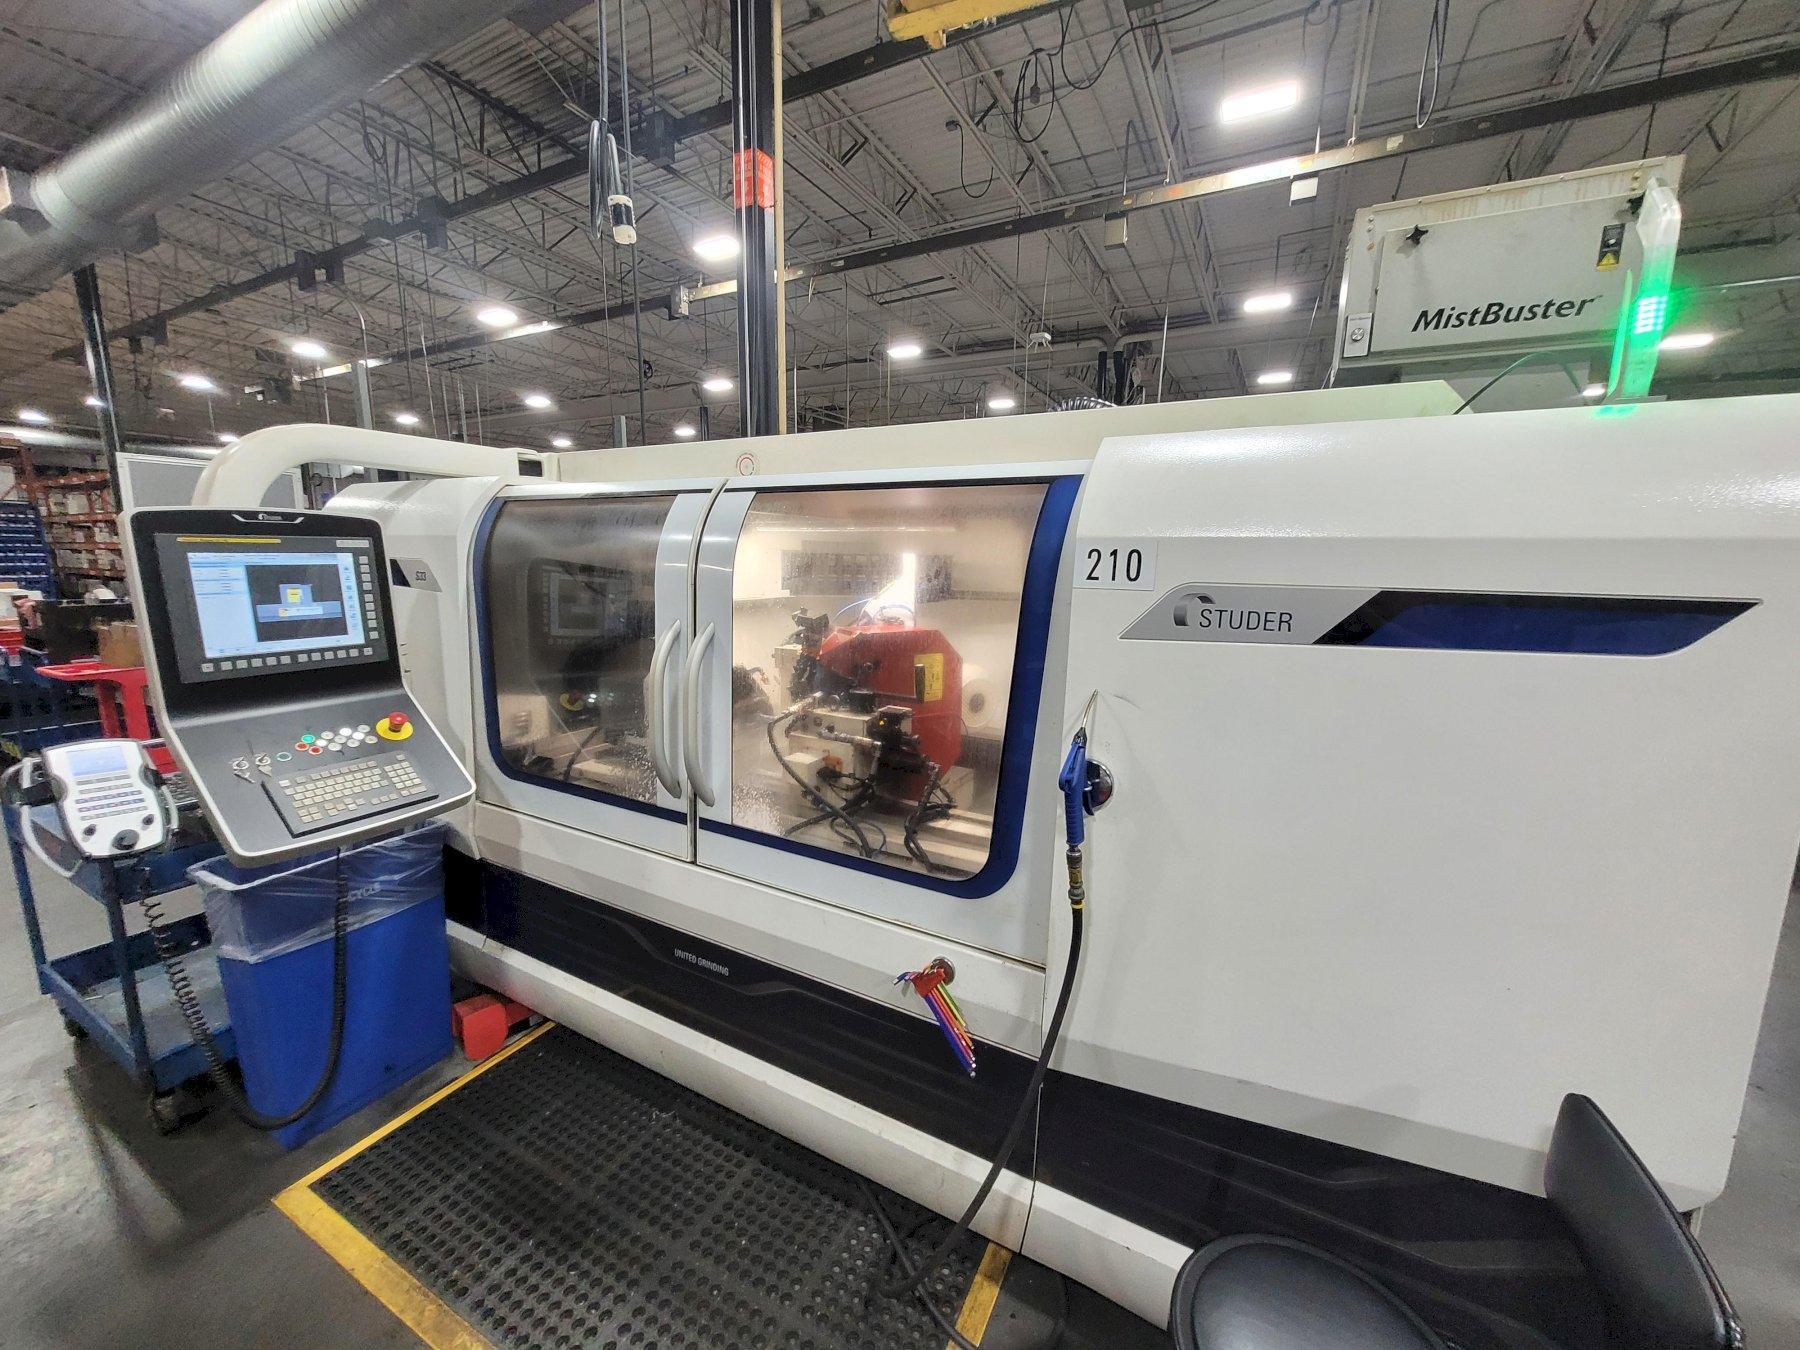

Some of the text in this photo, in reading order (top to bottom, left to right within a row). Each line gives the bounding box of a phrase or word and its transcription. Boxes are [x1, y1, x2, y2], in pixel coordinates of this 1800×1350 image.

[1411, 297, 1597, 332] MistBuster
[1086, 548, 1143, 582] 210
[1199, 608, 1293, 632] STUDER
[674, 948, 729, 976] UNITED GRINDING
